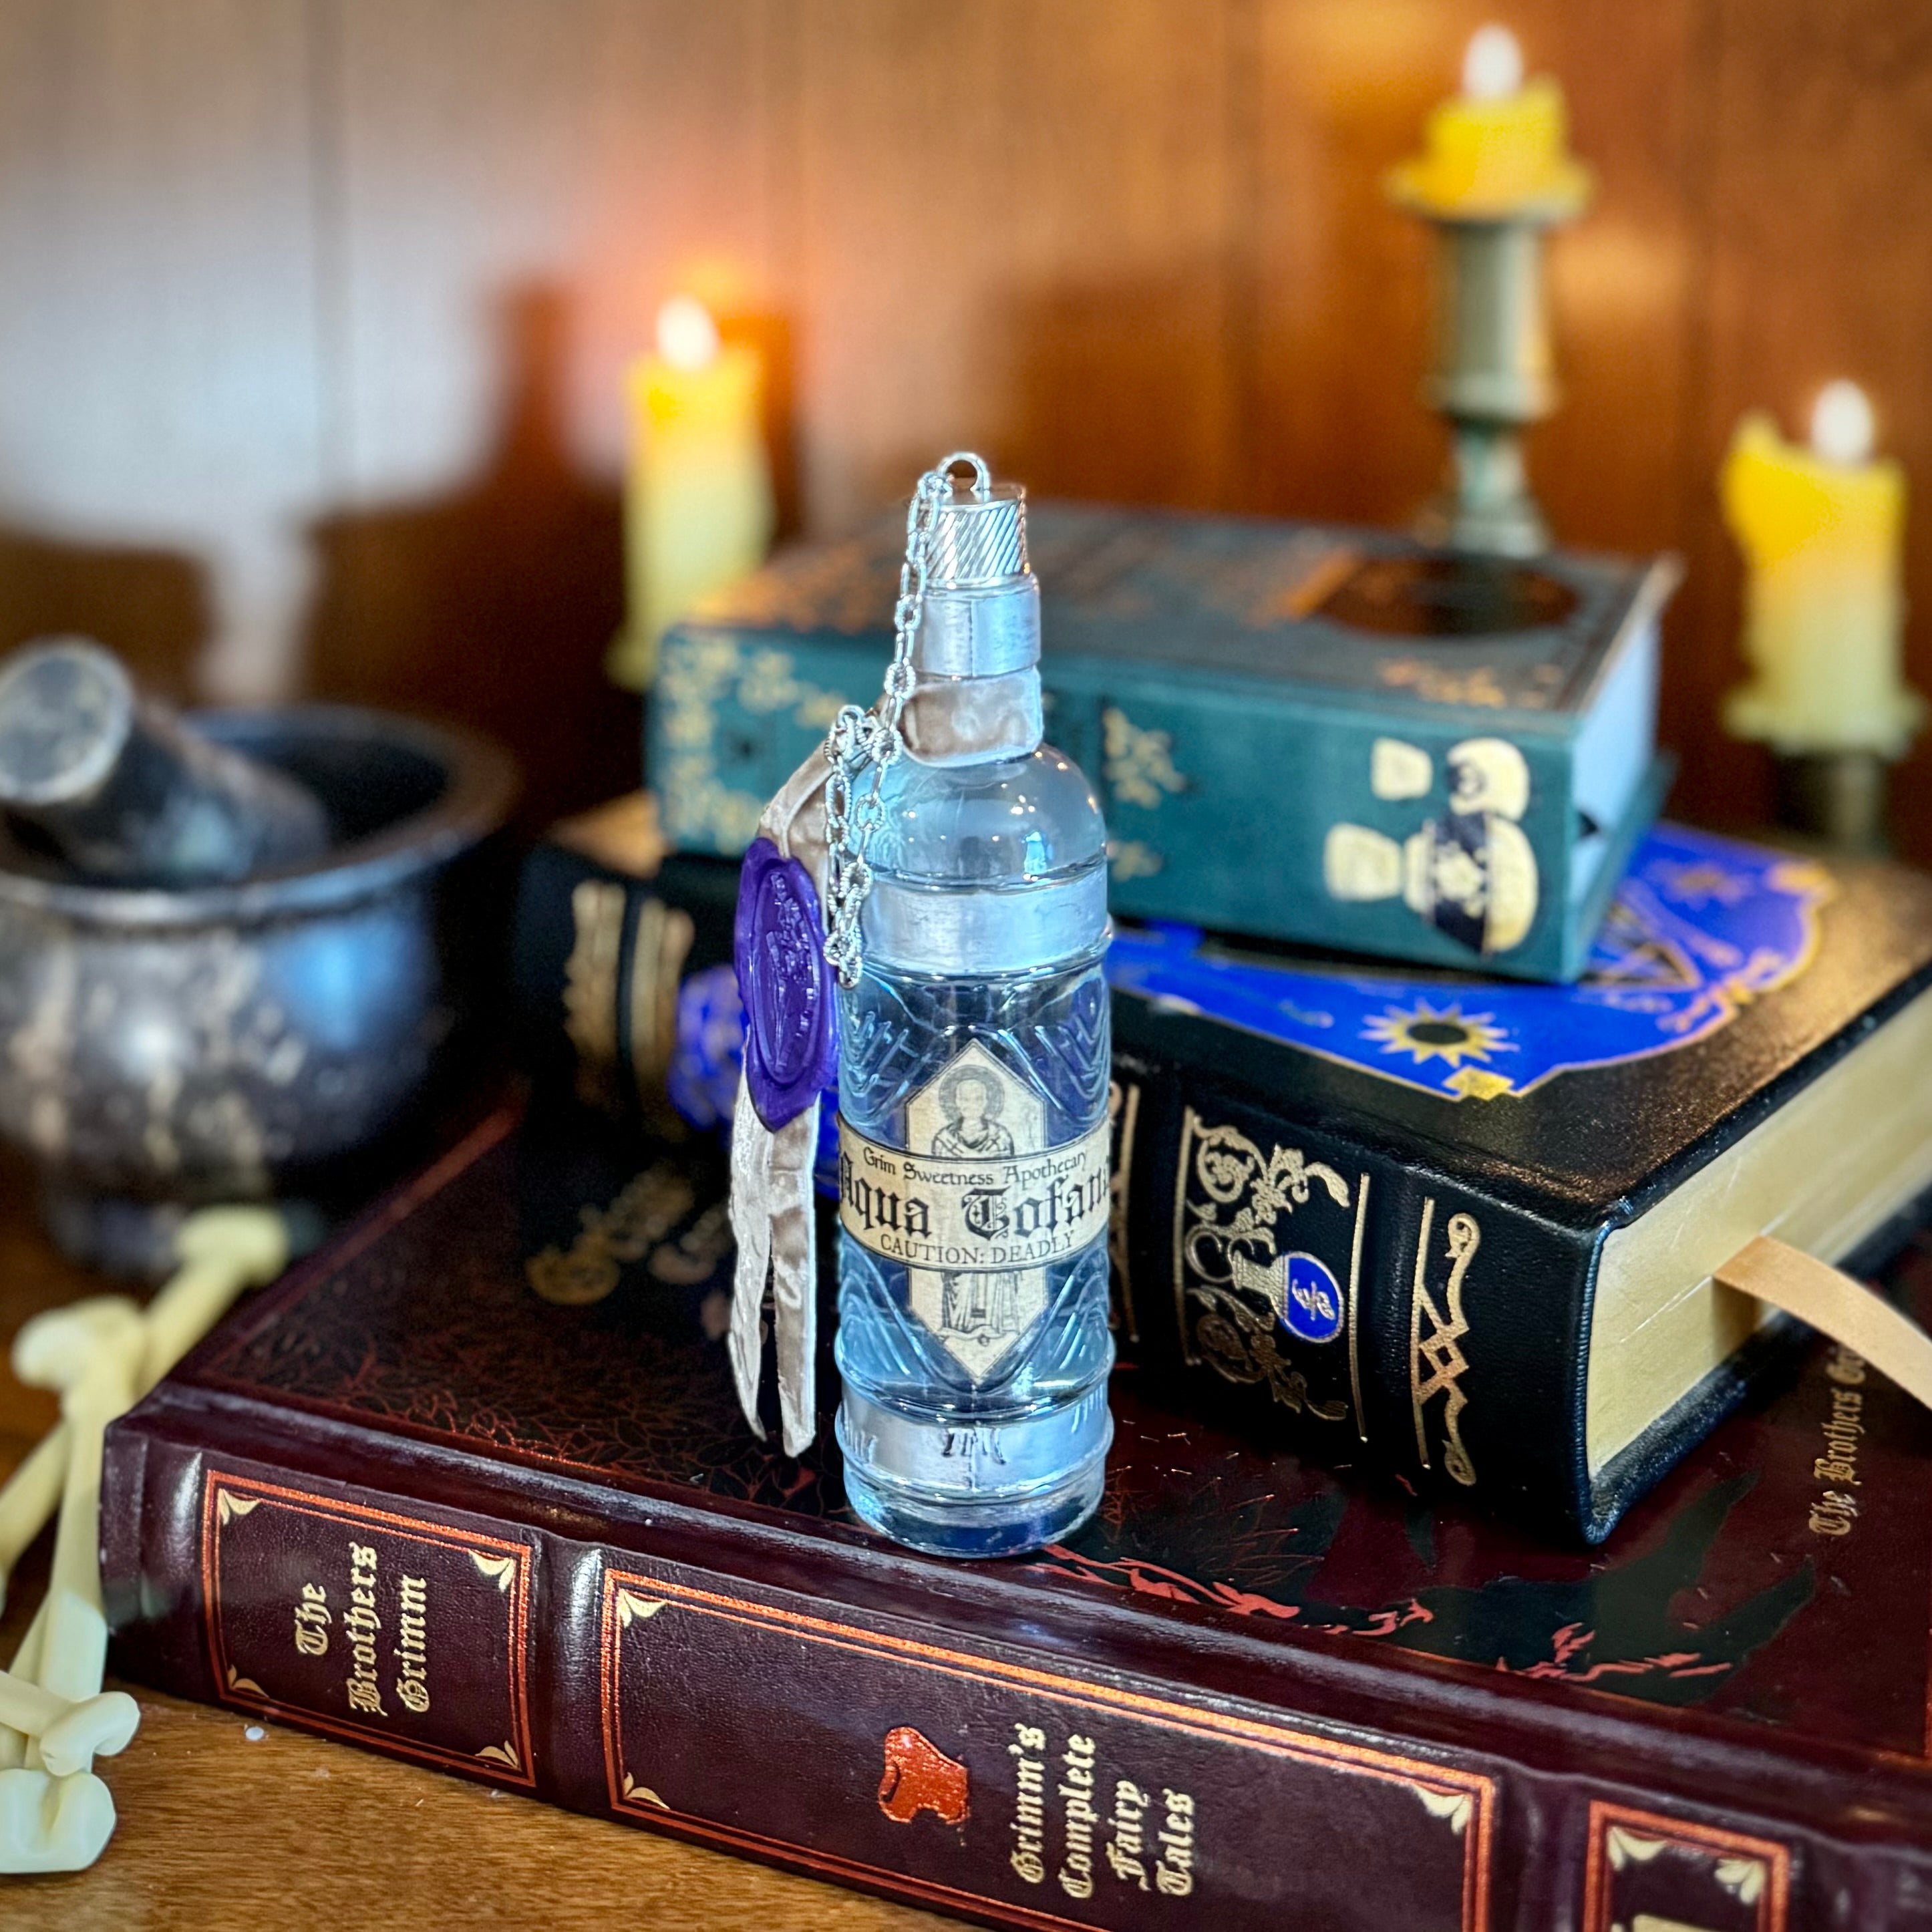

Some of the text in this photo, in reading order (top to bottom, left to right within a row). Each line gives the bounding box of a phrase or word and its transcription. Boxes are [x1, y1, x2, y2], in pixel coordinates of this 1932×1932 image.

[840, 1151, 933, 1239] Aqua
[863, 1146, 1087, 1190] Grim Sweetness Apothecary
[880, 1230, 1074, 1265] CAUTION: DEADLY
[1813, 1388, 1865, 1486] Brothers
[1808, 1490, 1859, 1536] The
[295, 1582, 332, 1655] The
[343, 1541, 389, 1717] Brothers
[393, 1574, 430, 1712] Grimm
[1007, 1722, 1045, 1884] Grimm's
[1058, 1734, 1100, 1899] Complete
[1106, 1780, 1151, 1892] Fairy
[1156, 1788, 1195, 1896] Tales
